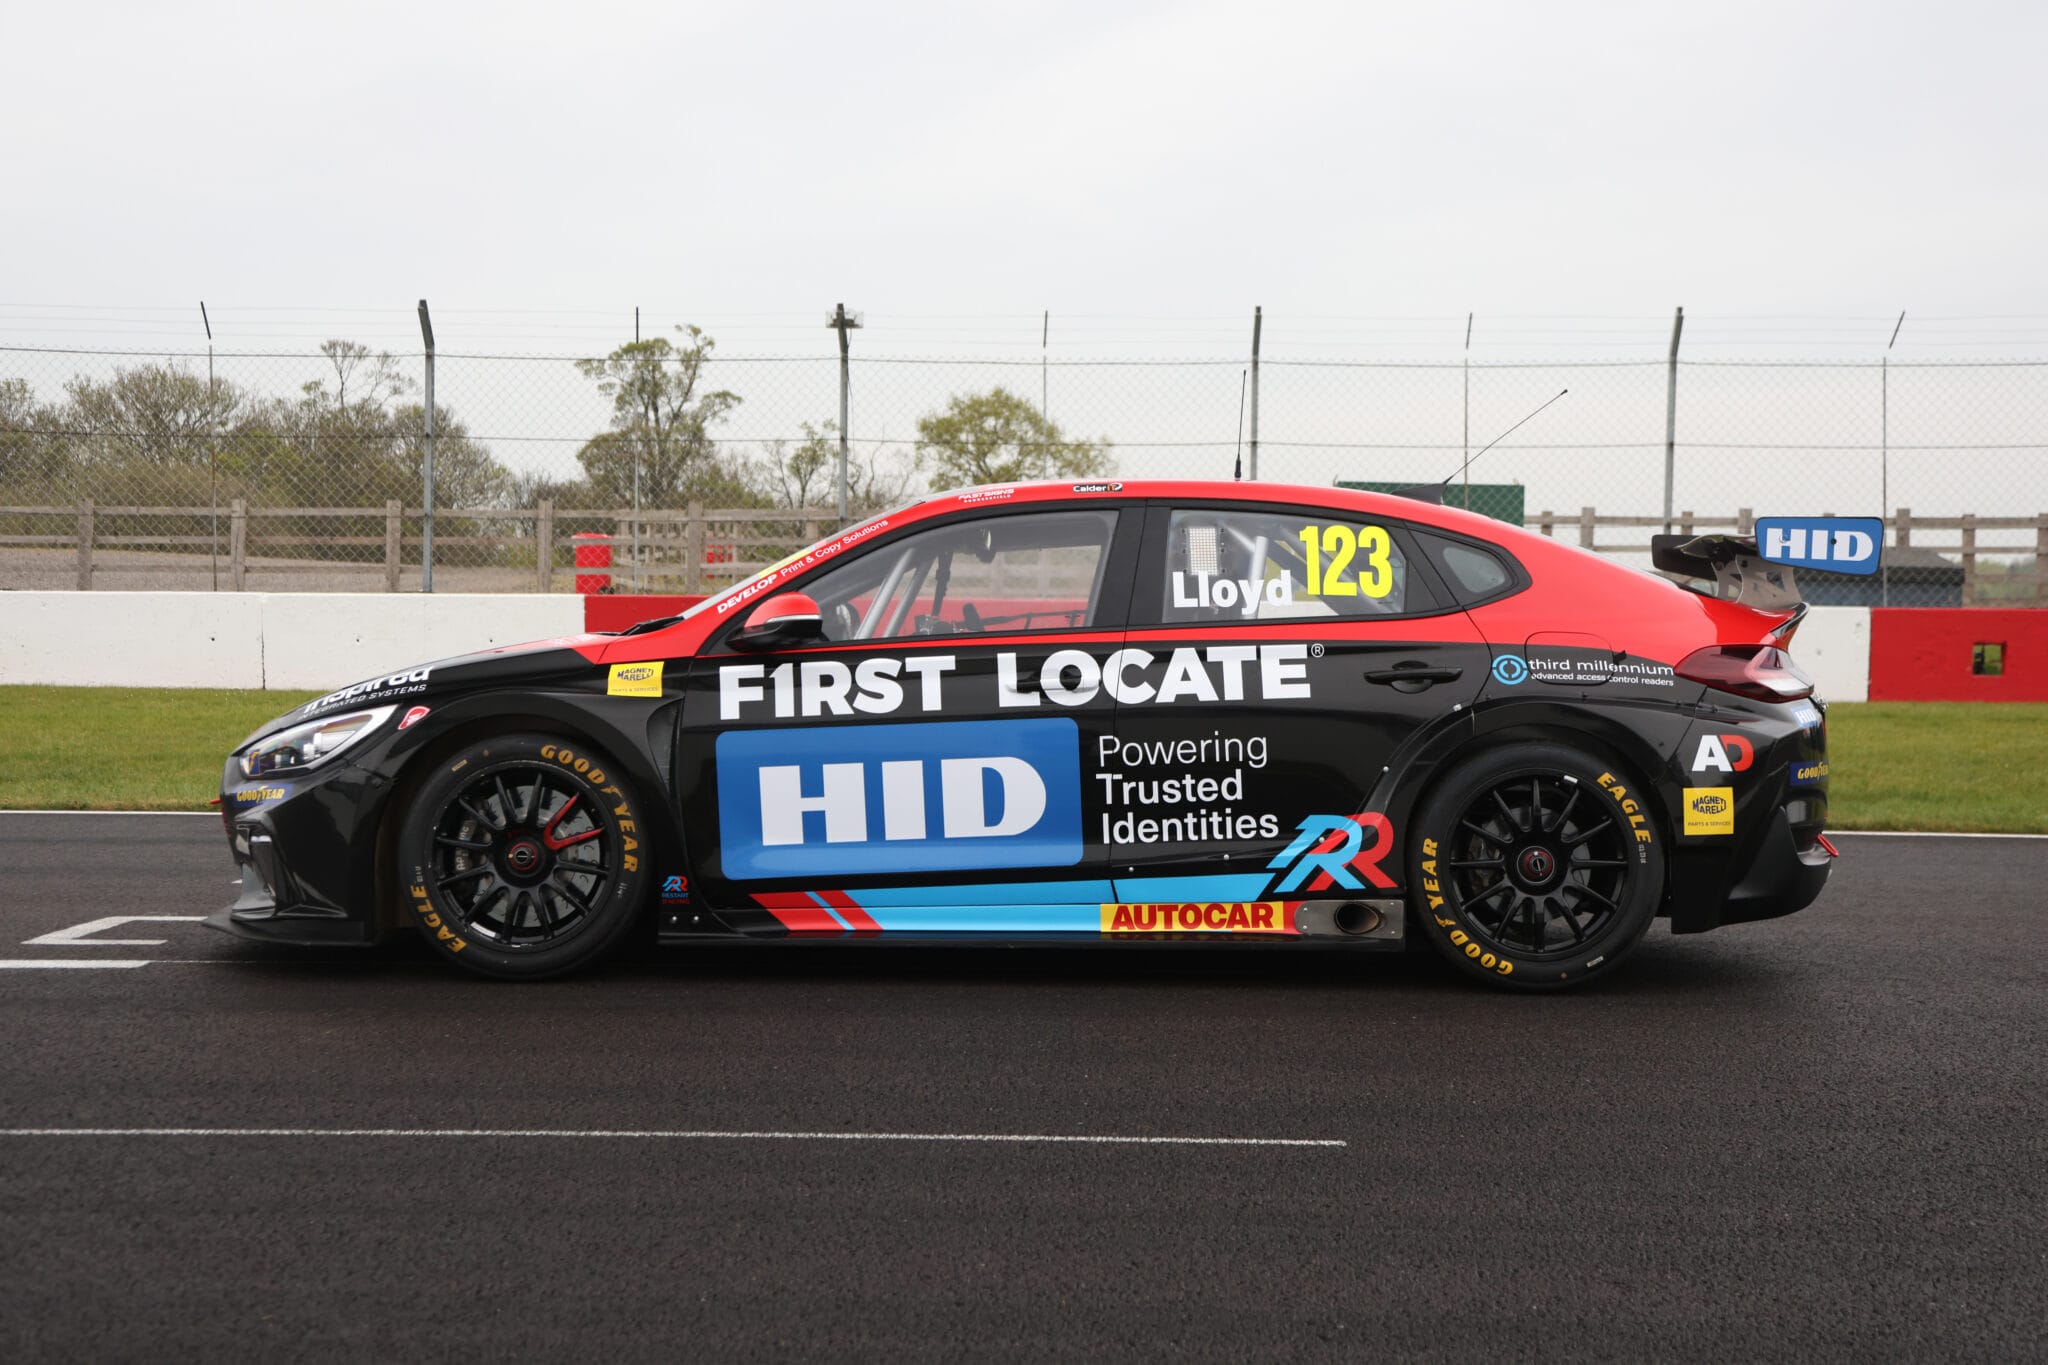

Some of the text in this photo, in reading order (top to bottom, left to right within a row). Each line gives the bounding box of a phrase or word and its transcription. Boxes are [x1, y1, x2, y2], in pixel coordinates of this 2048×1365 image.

[958, 489, 1014, 500] FASTSIGNS
[1300, 525, 1393, 598] 123
[1765, 527, 1874, 561] HID
[717, 573, 778, 614] DEVELOP
[780, 561, 805, 577] Print
[815, 541, 842, 558] Copy
[842, 520, 889, 545] Solutions
[1172, 569, 1292, 615] Lloyd
[1529, 659, 1674, 676] third millennium
[1531, 672, 1674, 687] advanced access control readers
[368, 684, 427, 701] SYSTEMS
[1099, 731, 1268, 768] Powering
[759, 756, 1047, 846] HID
[1096, 769, 1243, 805] Trusted
[1597, 771, 1651, 844] EAGLE
[1102, 808, 1280, 844] Identities
[410, 884, 467, 953] EAGLE
[1111, 903, 1273, 930] AUTOCAR
